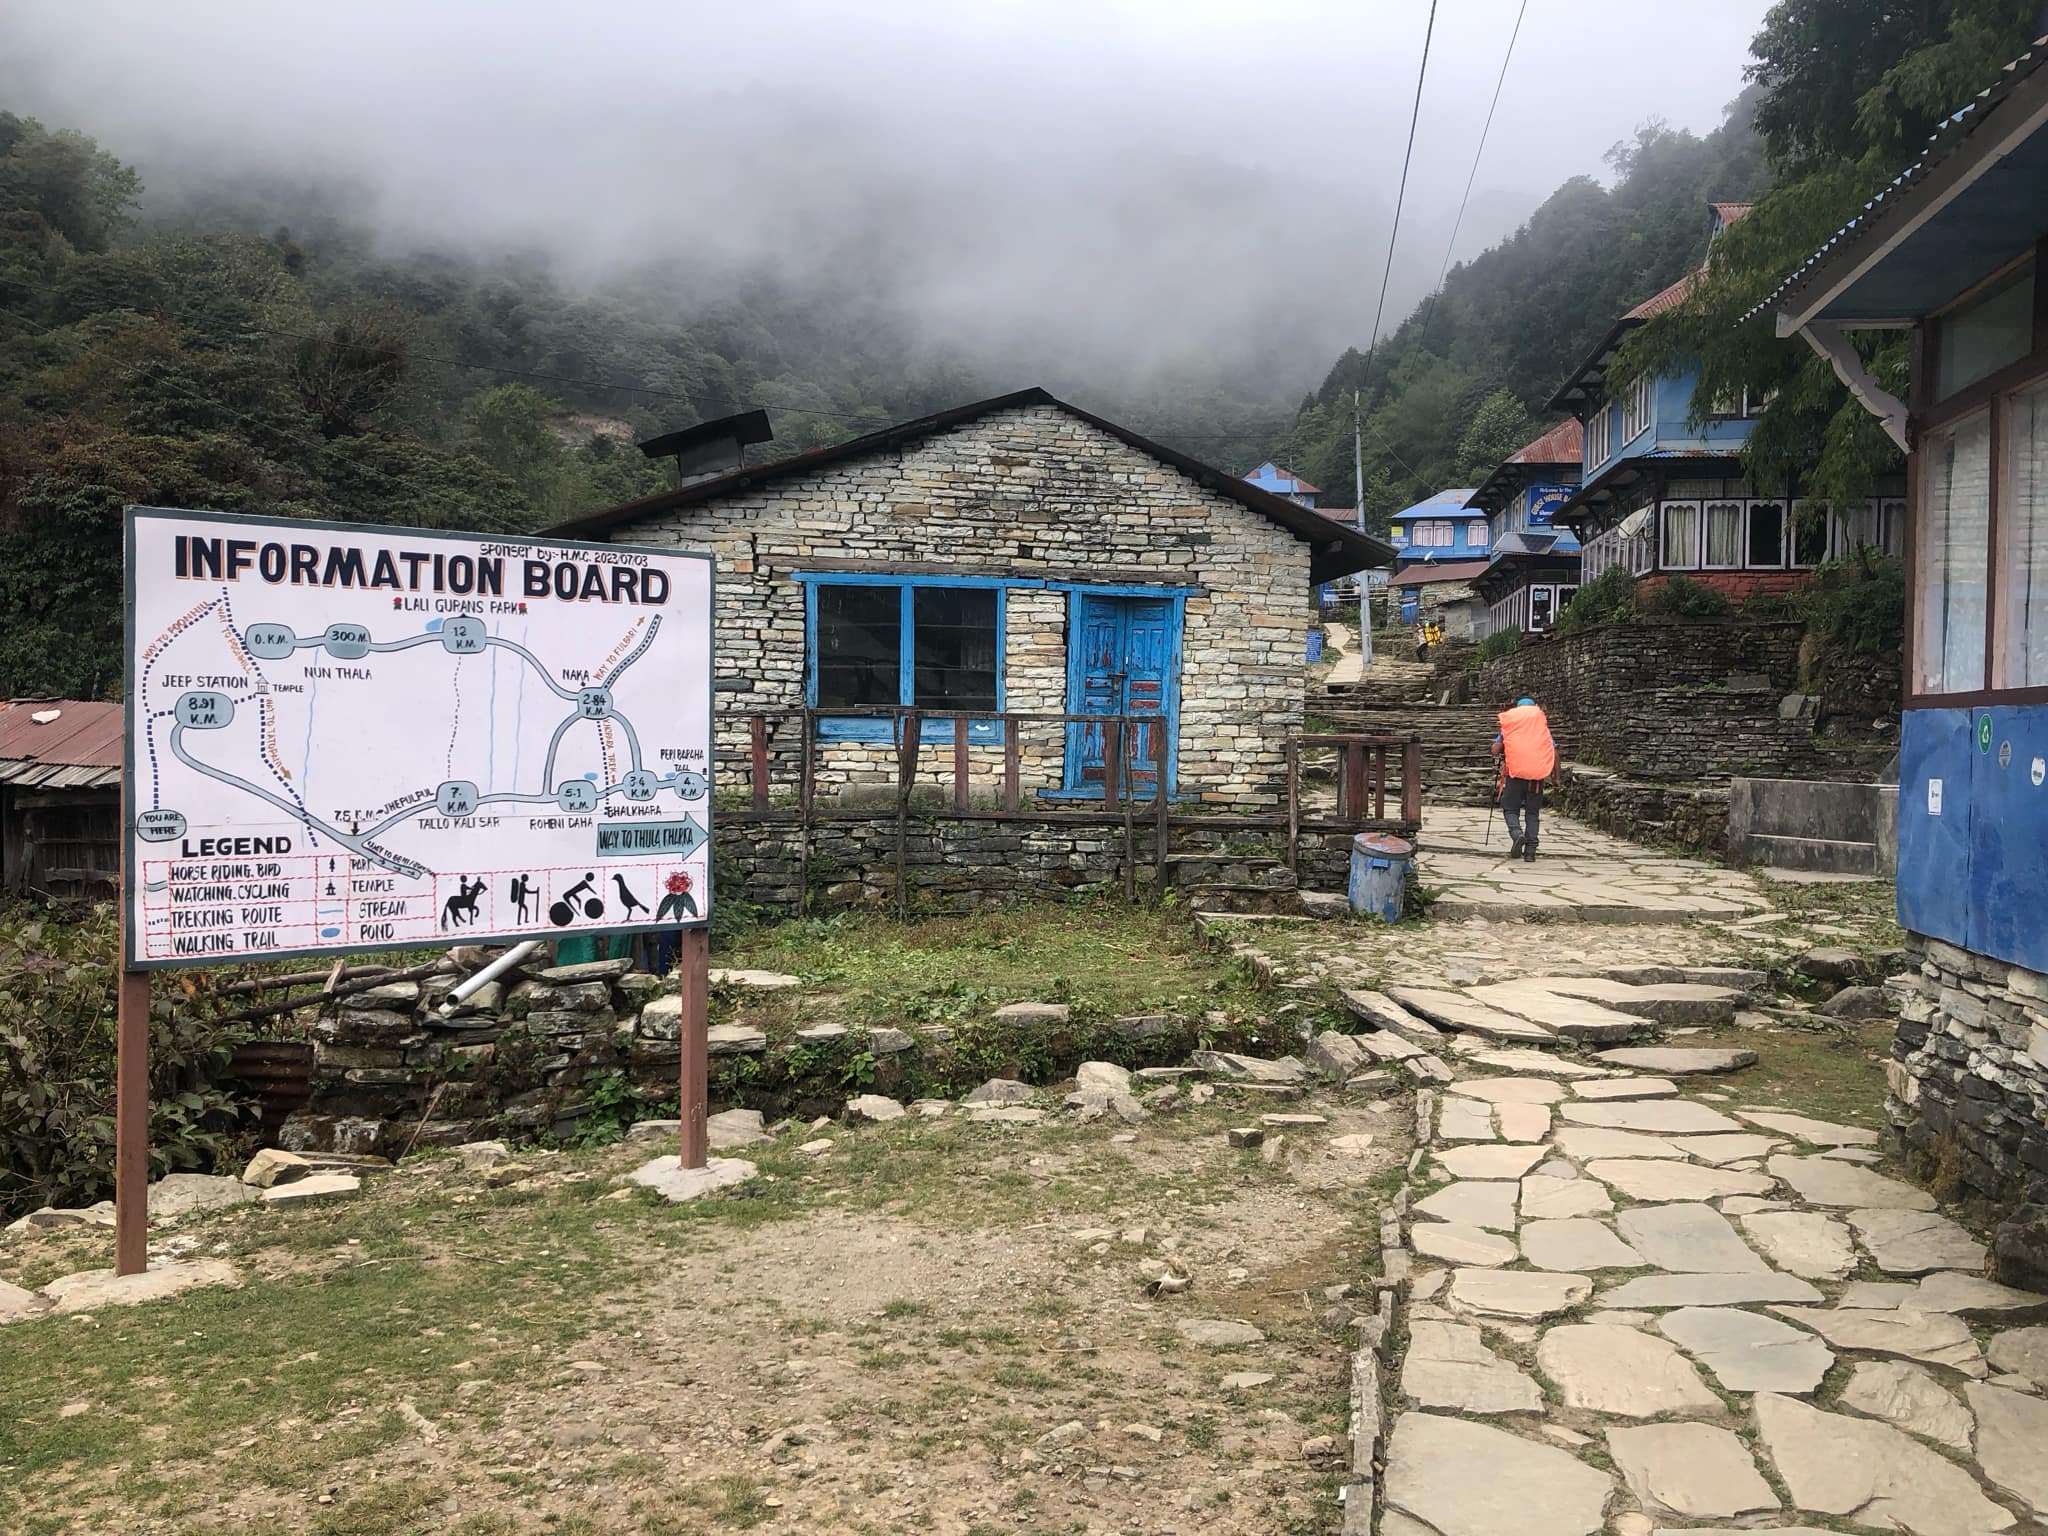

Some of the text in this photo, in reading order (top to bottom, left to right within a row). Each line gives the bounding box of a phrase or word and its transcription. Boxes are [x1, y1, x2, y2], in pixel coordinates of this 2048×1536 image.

[175, 534, 671, 607] INFORMATION BOARD
[404, 597, 518, 614] LALI GURANS PARK
[331, 630, 355, 642] 300
[304, 666, 372, 680] NUN THALA
[562, 668, 590, 681] NAKA
[592, 664, 609, 681] WAY
[606, 654, 617, 665] TO
[162, 675, 249, 689] JEEP STATION
[272, 683, 304, 693] TEMPLE
[144, 813, 180, 823] YOU ARE
[418, 818, 450, 830] TALLO
[454, 817, 476, 829] KALI
[568, 817, 593, 828] DAHA
[150, 826, 177, 835] HERE
[182, 836, 292, 858] LEGEND
[599, 830, 619, 850] WAY
[621, 829, 633, 848] TO
[634, 828, 661, 848] THULA
[170, 864, 207, 881] HORSE
[256, 863, 281, 878] BIRD
[351, 878, 395, 893] TEMPLE
[358, 900, 407, 918] STREAM
[171, 906, 283, 929] TREKKING ROUTE
[360, 923, 394, 940] POND
[173, 931, 279, 954] WALKING TRAIL
